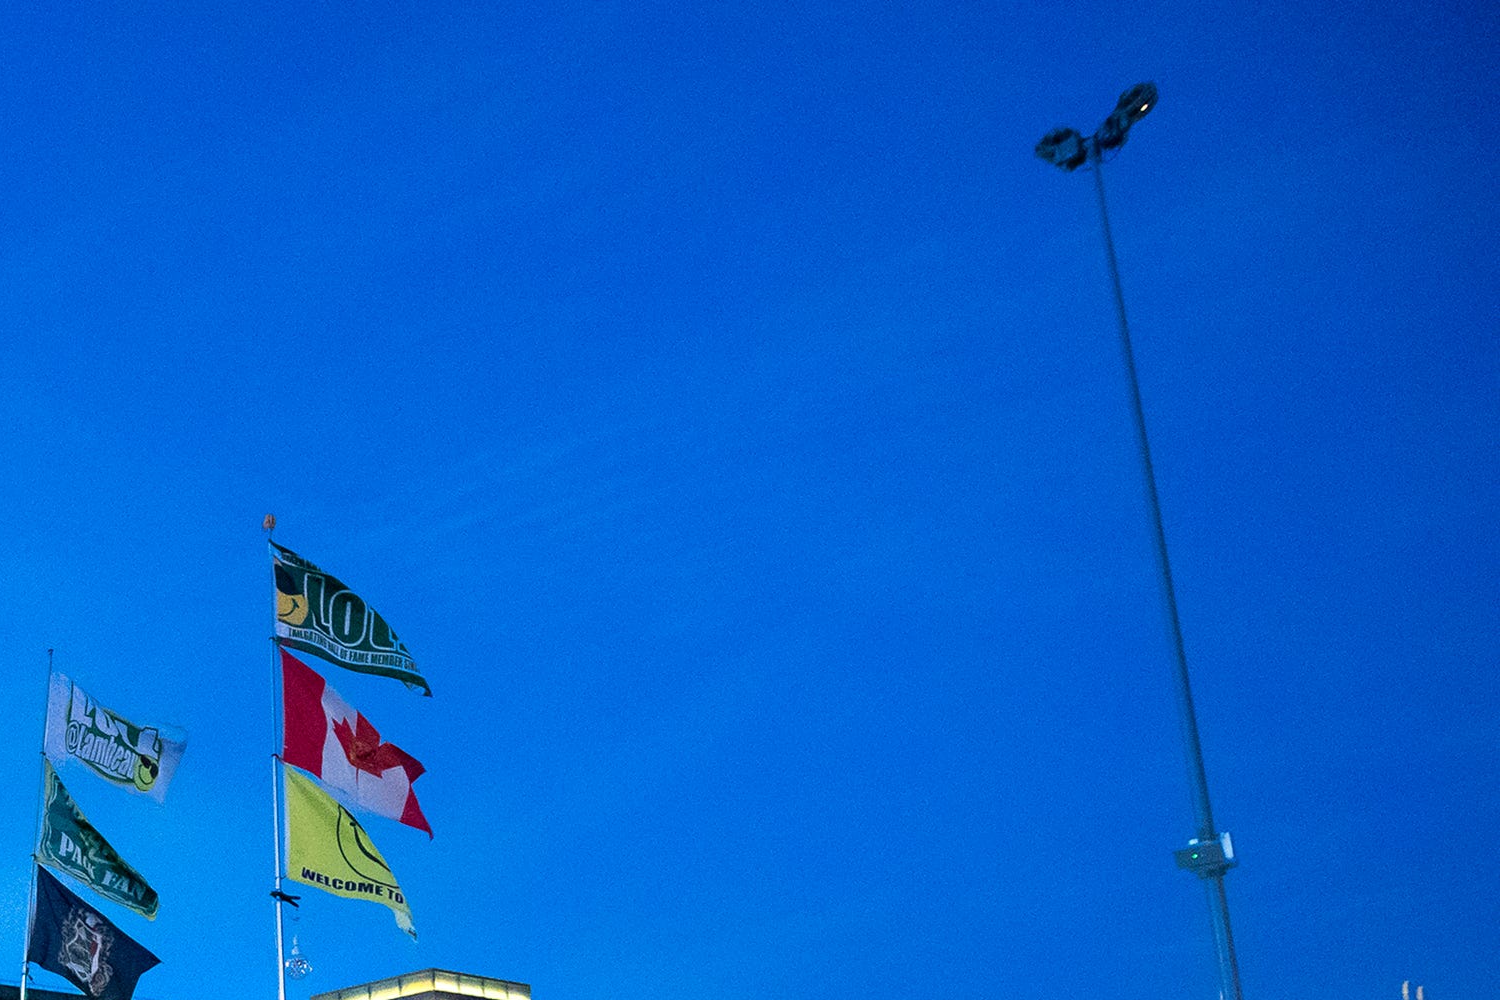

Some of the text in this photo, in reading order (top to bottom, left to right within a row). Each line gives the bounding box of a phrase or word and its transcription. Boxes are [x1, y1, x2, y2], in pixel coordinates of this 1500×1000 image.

[350, 652, 370, 664] FAME
[301, 867, 404, 905] WELCOME TO
